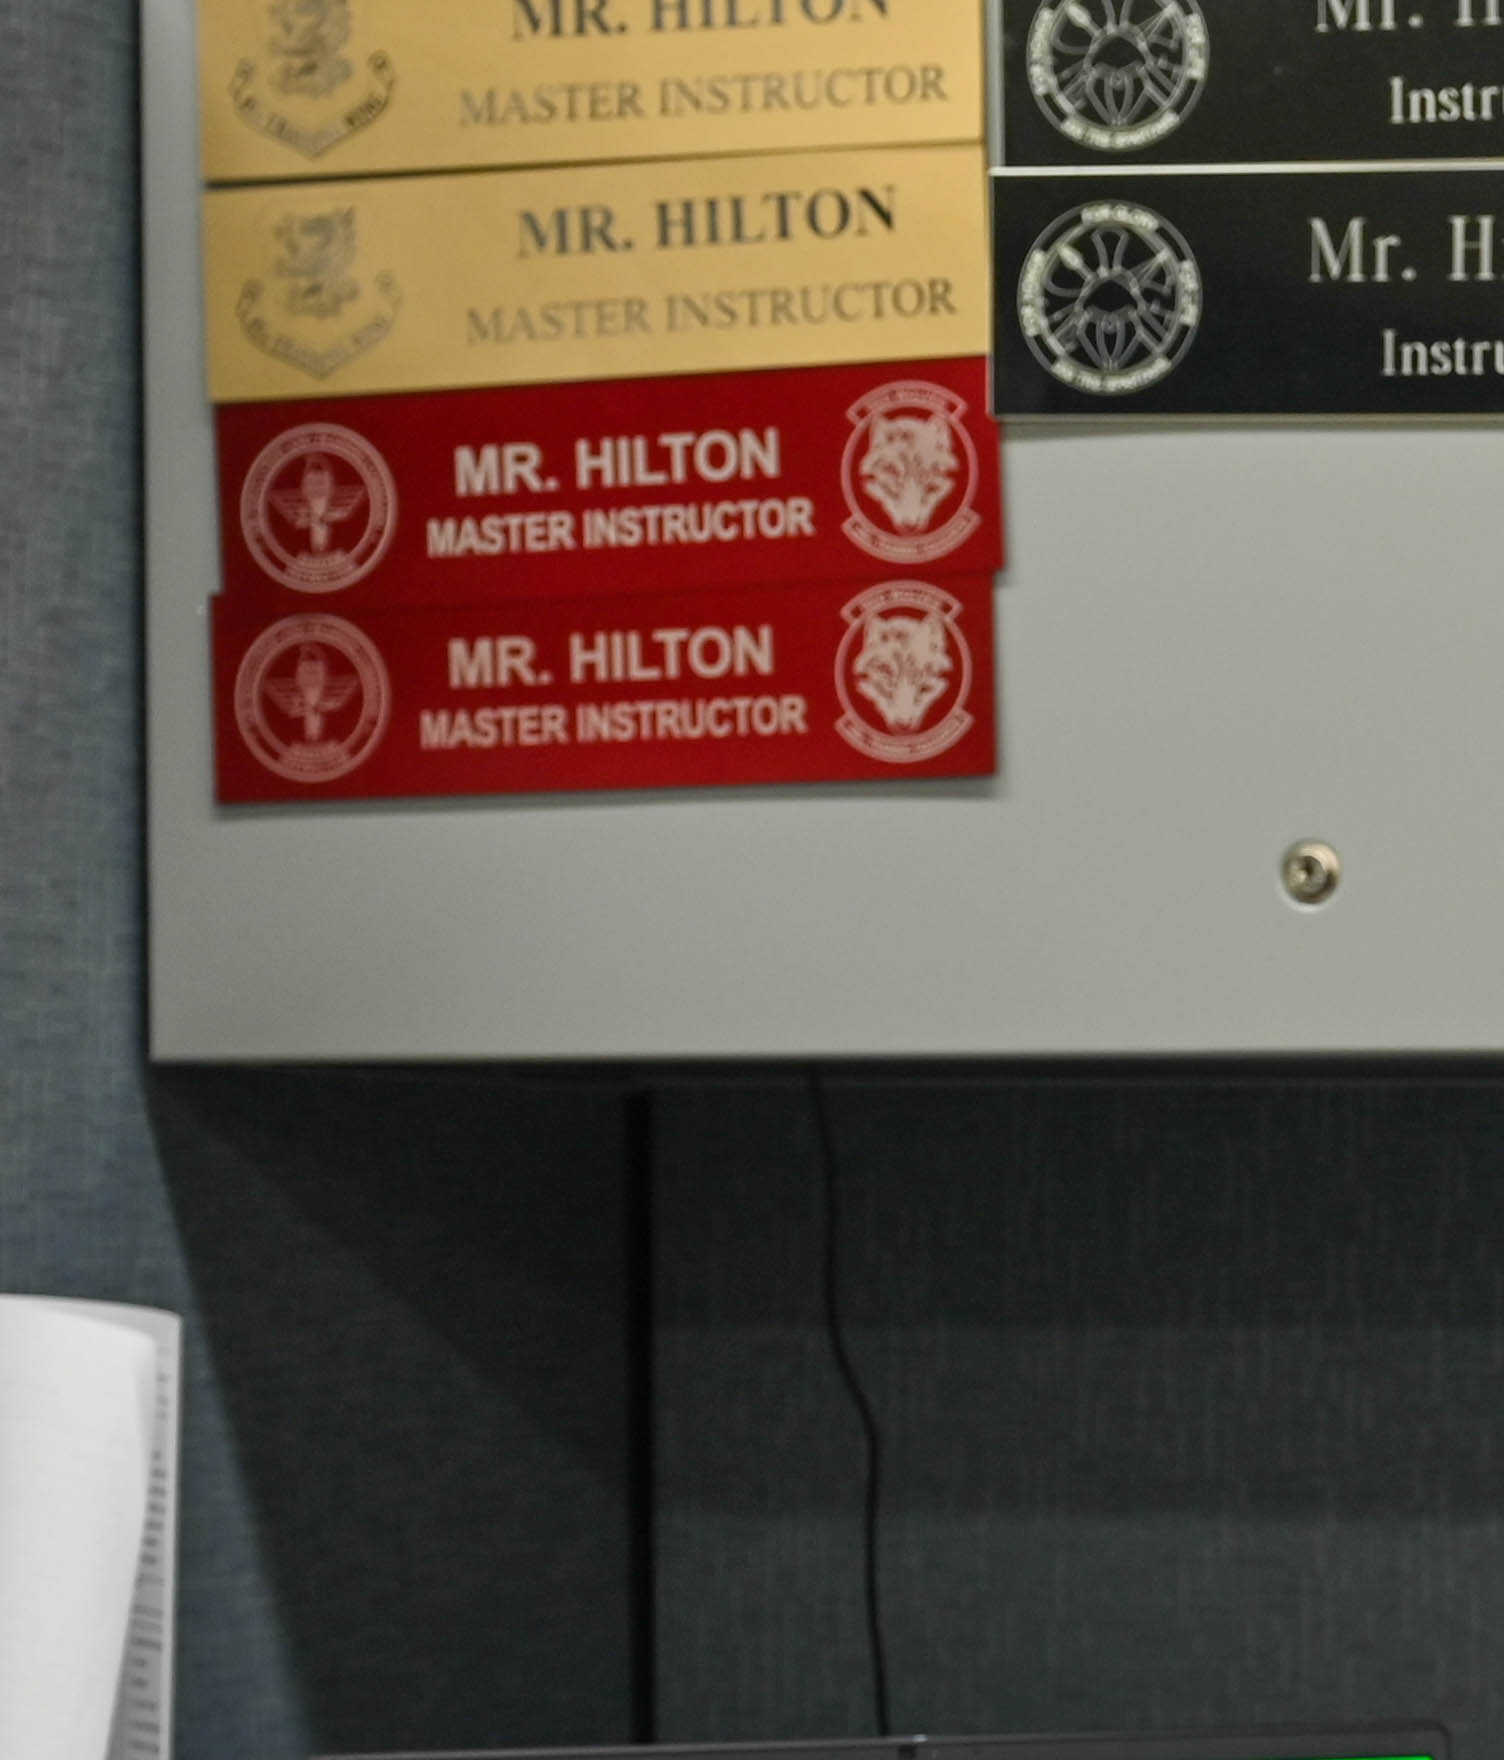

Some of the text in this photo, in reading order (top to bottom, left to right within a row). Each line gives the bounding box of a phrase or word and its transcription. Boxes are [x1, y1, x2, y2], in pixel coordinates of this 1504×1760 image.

[512, 0, 627, 41] MR.
[457, 63, 947, 127] MASTER INSTRUCTOR
[516, 185, 896, 259] MR. HILTON
[1308, 216, 1417, 283] Mr.
[466, 277, 957, 347] MASTER INSTRUCTOR
[454, 442, 559, 496] MR.
[574, 426, 780, 489] HILTON
[427, 510, 576, 558] MASTER
[583, 497, 816, 548] INSTRUCTOR
[447, 635, 553, 688] MR.
[569, 624, 774, 683] HILTON
[420, 704, 569, 750] MASTER
[577, 695, 808, 743] INSTRUCTOR
